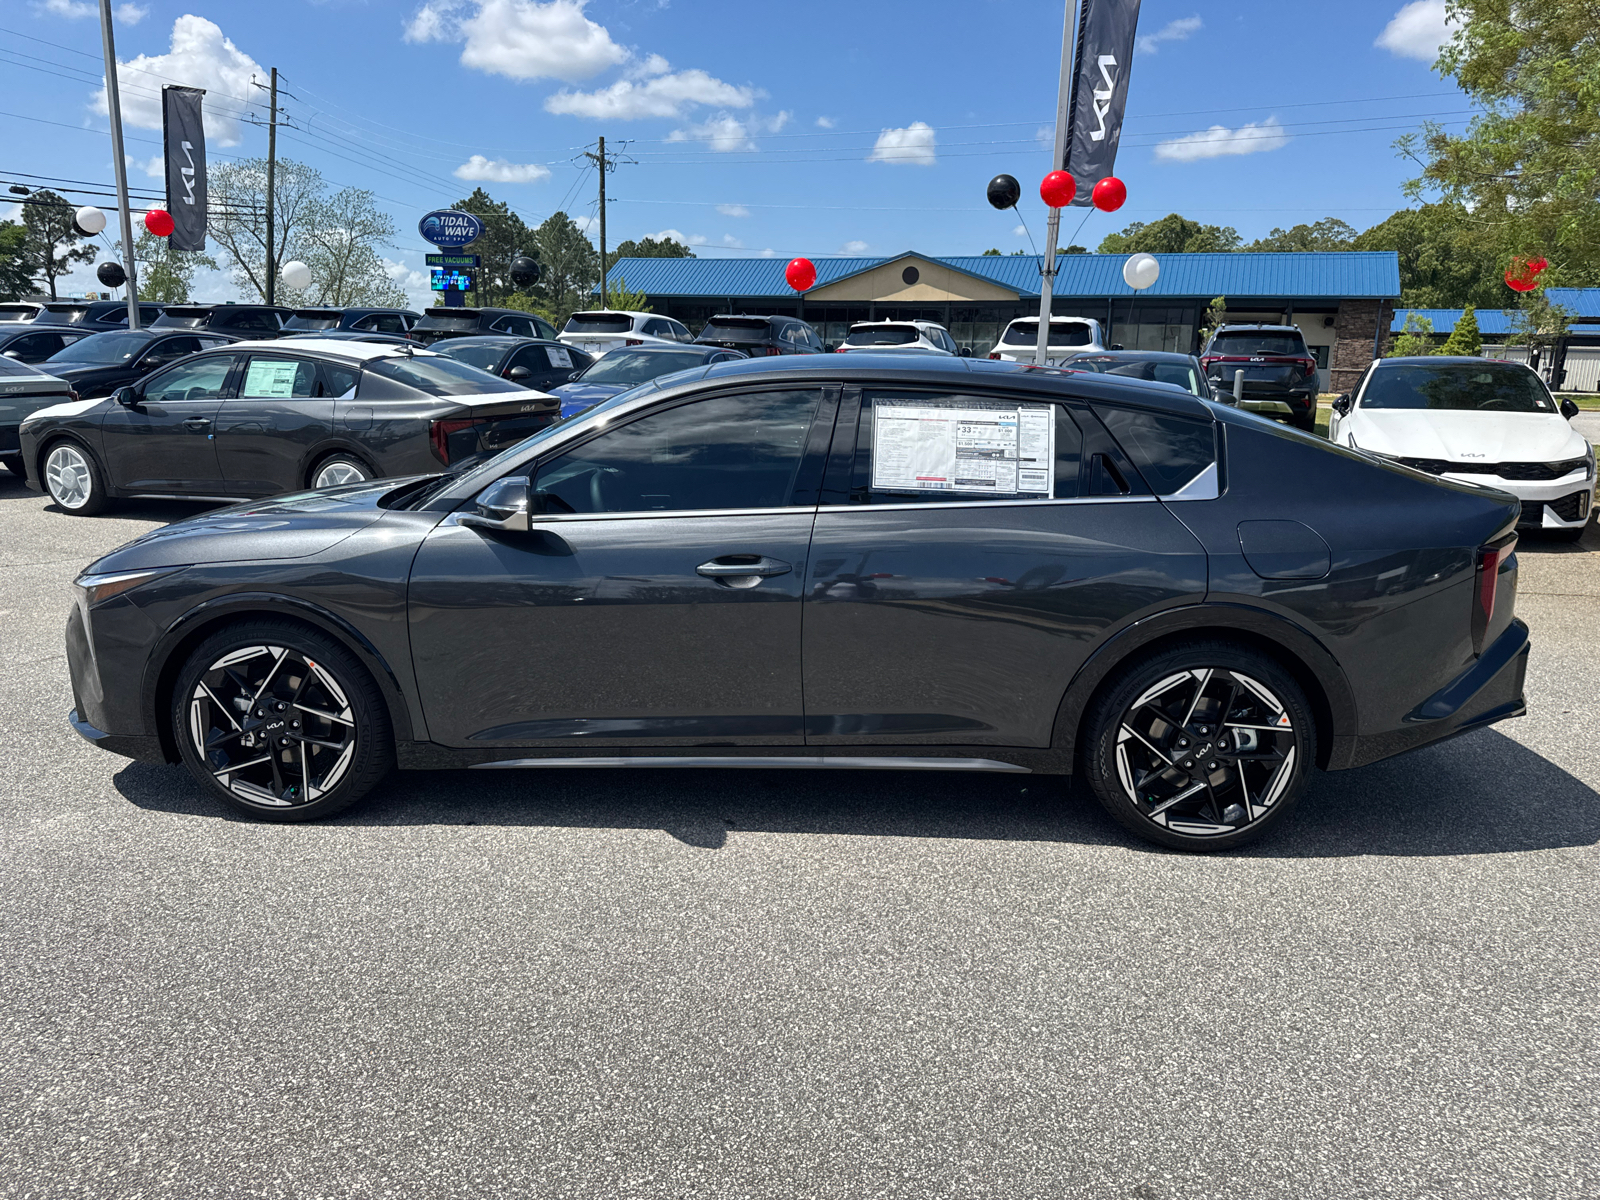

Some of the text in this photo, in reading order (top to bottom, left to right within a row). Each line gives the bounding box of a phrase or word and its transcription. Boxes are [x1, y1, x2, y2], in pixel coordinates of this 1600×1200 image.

[1089, 55, 1117, 141] KIA
[181, 141, 195, 205] KIA
[440, 216, 469, 227] TIDAL
[445, 226, 475, 237] WAVE
[444, 256, 474, 264] VACUUMS
[520, 404, 536, 412] KIA
[961, 426, 972, 434] 33
[266, 720, 285, 730] KIA
[355, 724, 370, 774] KUMHO
[1195, 742, 1212, 759] KIA
